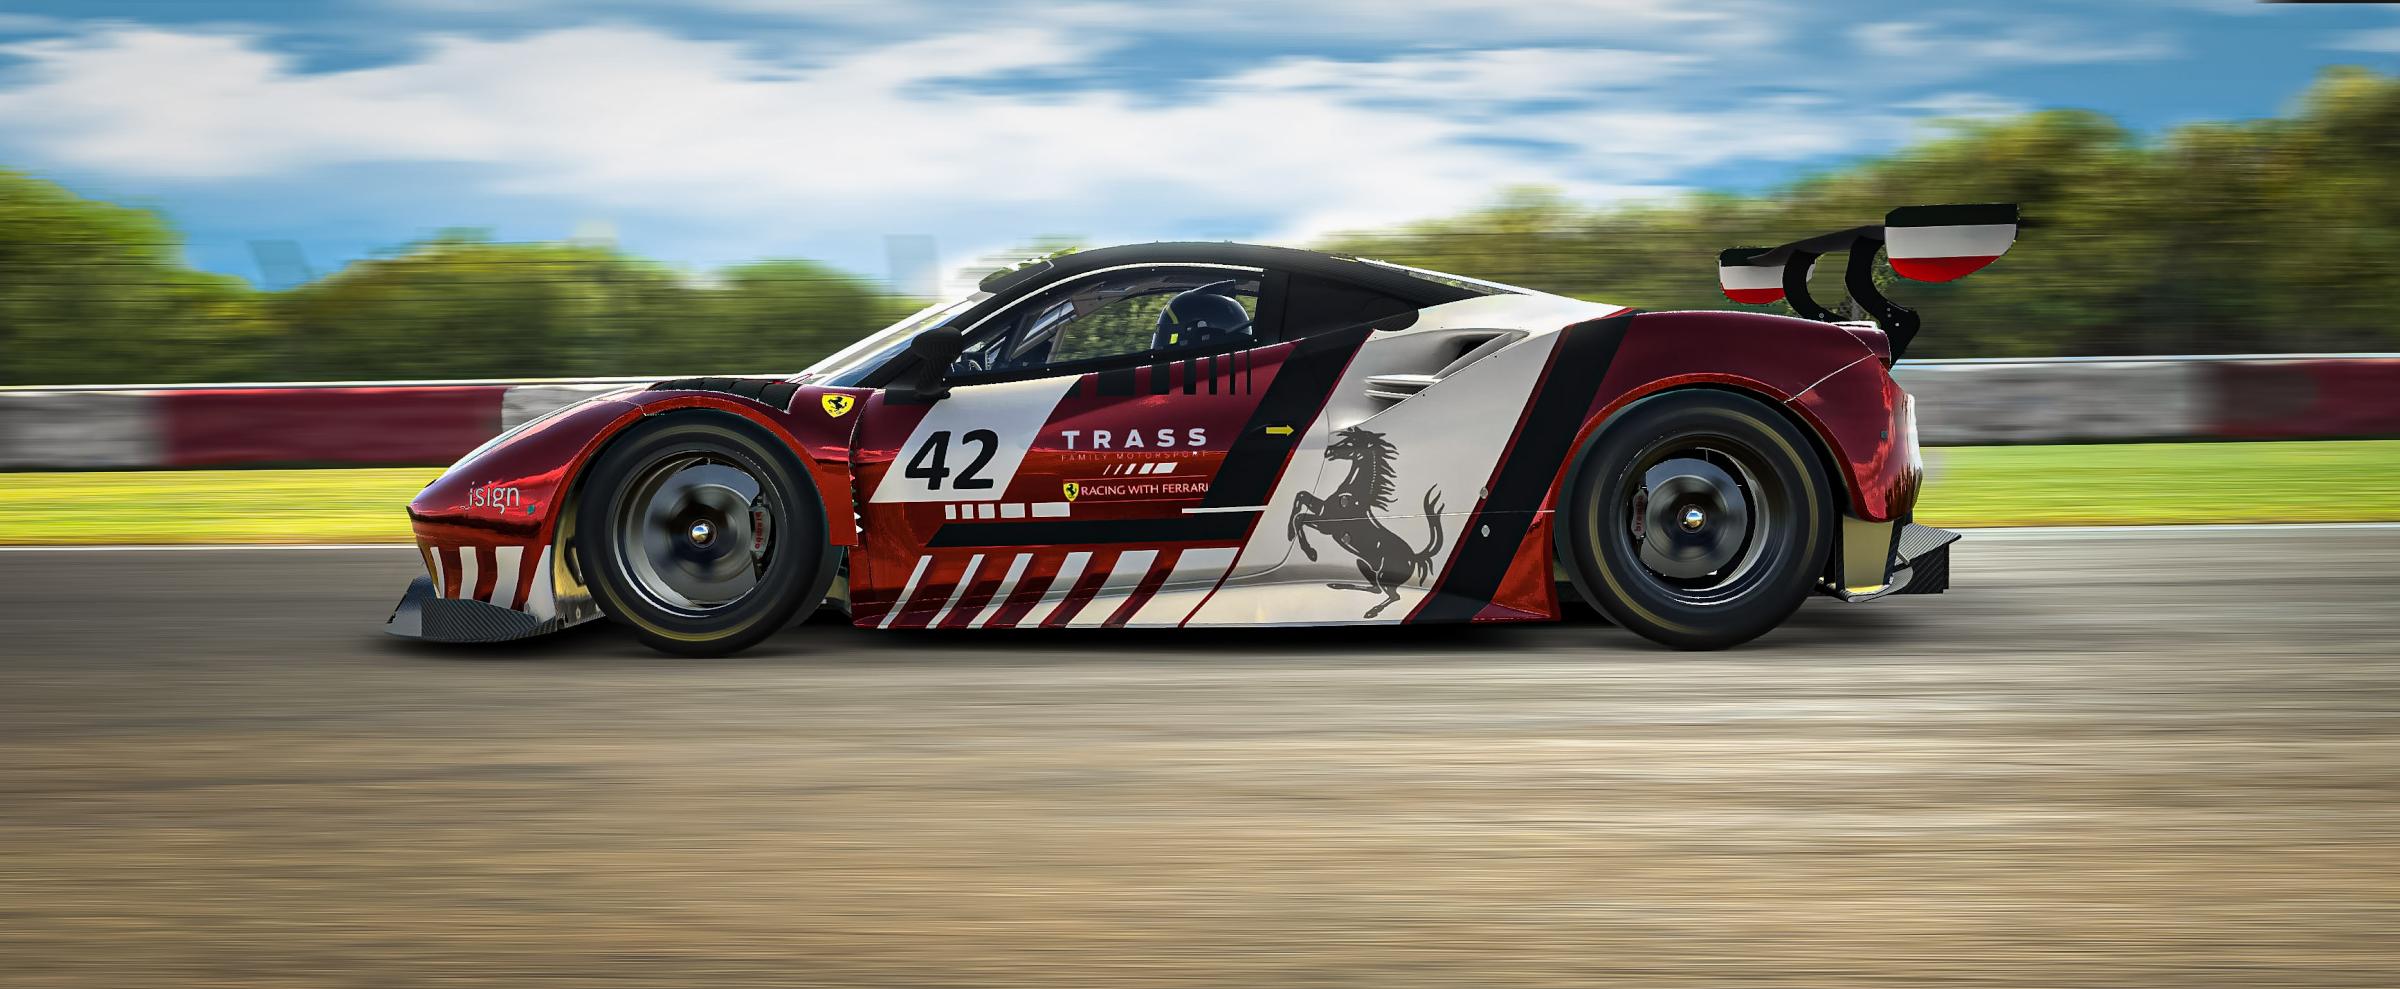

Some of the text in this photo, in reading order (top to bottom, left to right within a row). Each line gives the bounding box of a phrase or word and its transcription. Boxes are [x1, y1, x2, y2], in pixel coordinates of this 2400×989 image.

[1061, 427, 1207, 450] TRASS
[905, 429, 999, 490] 42
[1061, 454, 1108, 462] FAMILY
[1081, 482, 1209, 496] RACING WITH FERRARI
